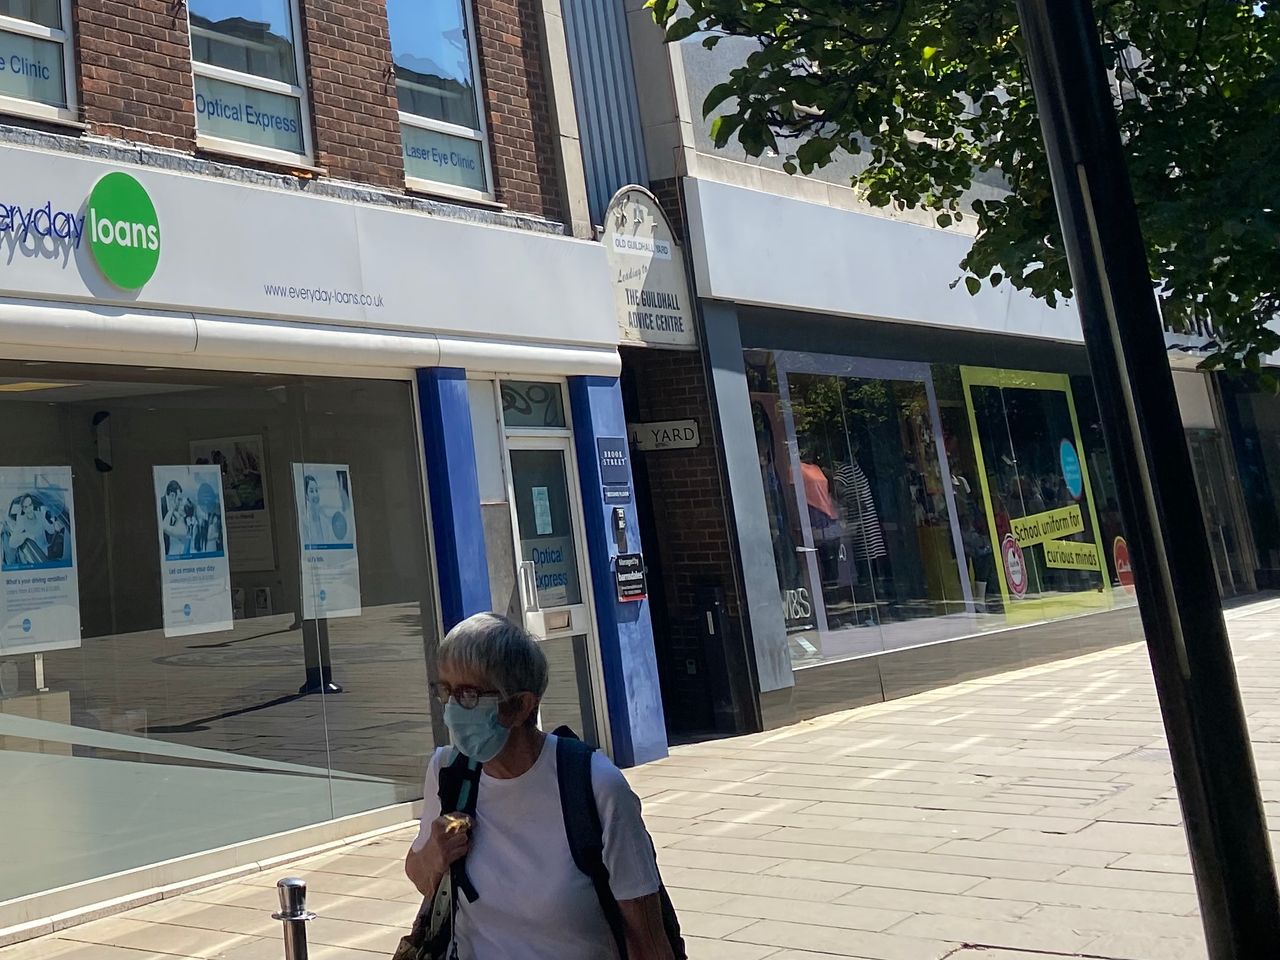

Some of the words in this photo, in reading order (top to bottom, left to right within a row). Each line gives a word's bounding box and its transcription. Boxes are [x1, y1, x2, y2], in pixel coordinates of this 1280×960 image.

[10, 55, 50, 81] Clinic
[195, 93, 243, 122] Optical
[245, 105, 298, 134] Express
[405, 142, 431, 161] Laser
[431, 148, 448, 167] Eye
[450, 152, 475, 170] Clinic
[90, 208, 159, 251] loans
[614, 239, 626, 248] OLD
[263, 284, 384, 307] www.everyday-loans.co.uk
[625, 288, 640, 306] THE
[641, 290, 681, 311] GUILDHALL
[628, 311, 655, 330] ADVICE
[655, 314, 685, 333] CENTRE
[651, 428, 695, 443] YARD
[1014, 521, 1042, 541] School
[1041, 514, 1070, 535] uniform
[1069, 511, 1080, 528] for
[532, 548, 564, 568] Optical
[1046, 546, 1075, 564] curious
[1075, 548, 1097, 566] minds
